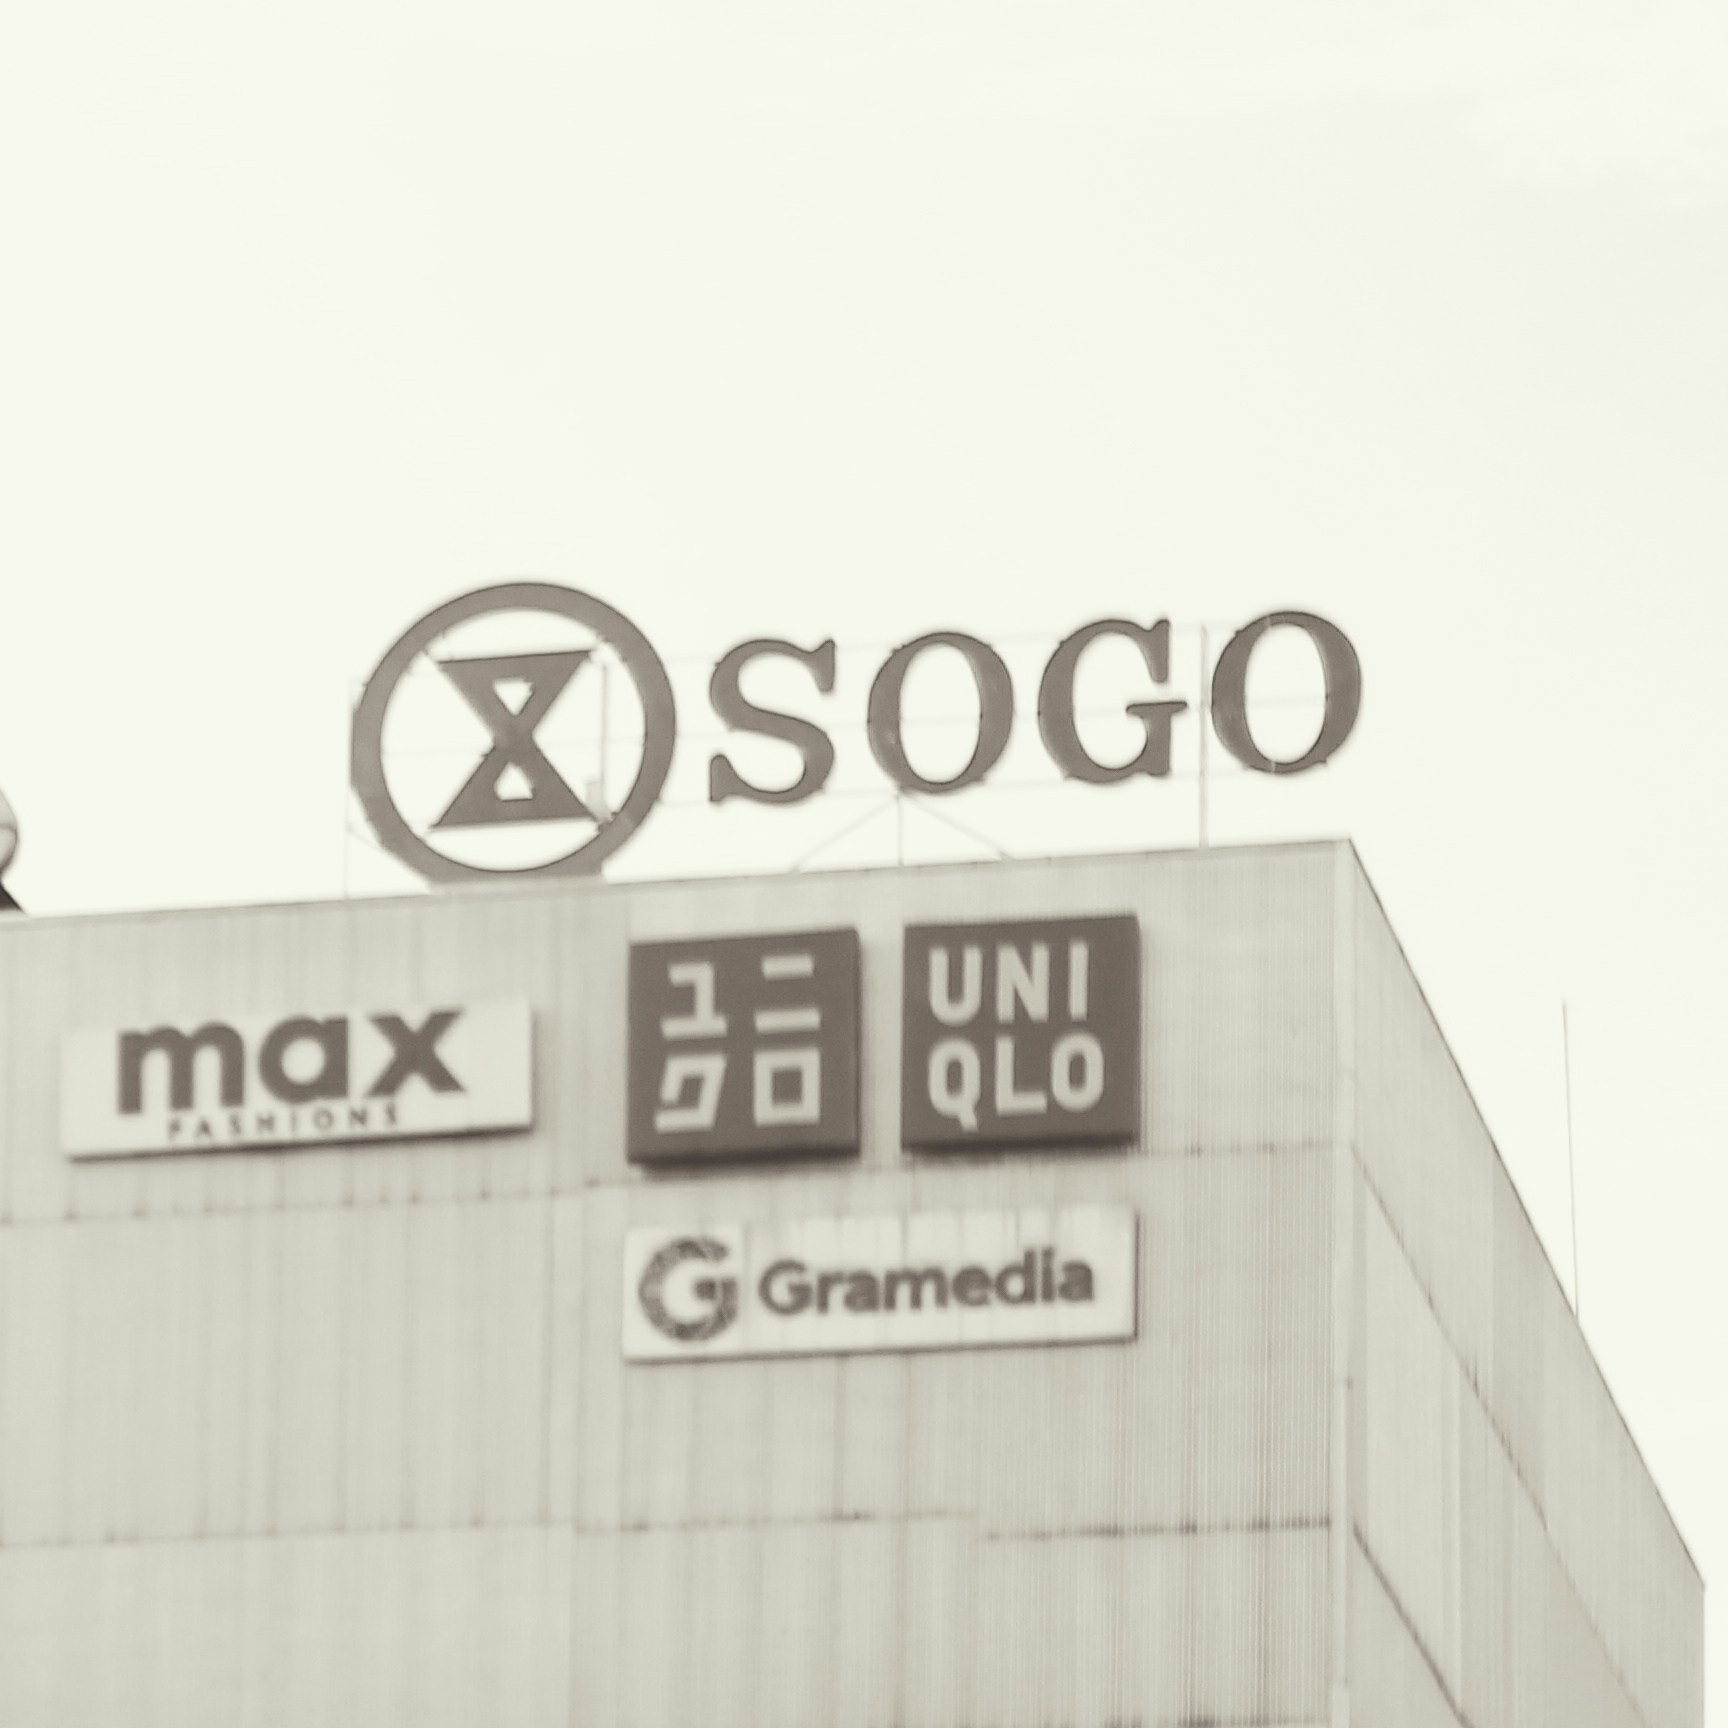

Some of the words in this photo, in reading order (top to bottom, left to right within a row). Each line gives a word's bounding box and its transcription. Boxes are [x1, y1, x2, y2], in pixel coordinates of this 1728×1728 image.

[708, 610, 1362, 804] SOGO
[926, 941, 1089, 1023] UNI
[118, 1009, 465, 1114] max
[926, 1034, 1104, 1128] QLO
[169, 1102, 399, 1141] FASHIONS
[757, 1243, 1096, 1315] Gramedia
